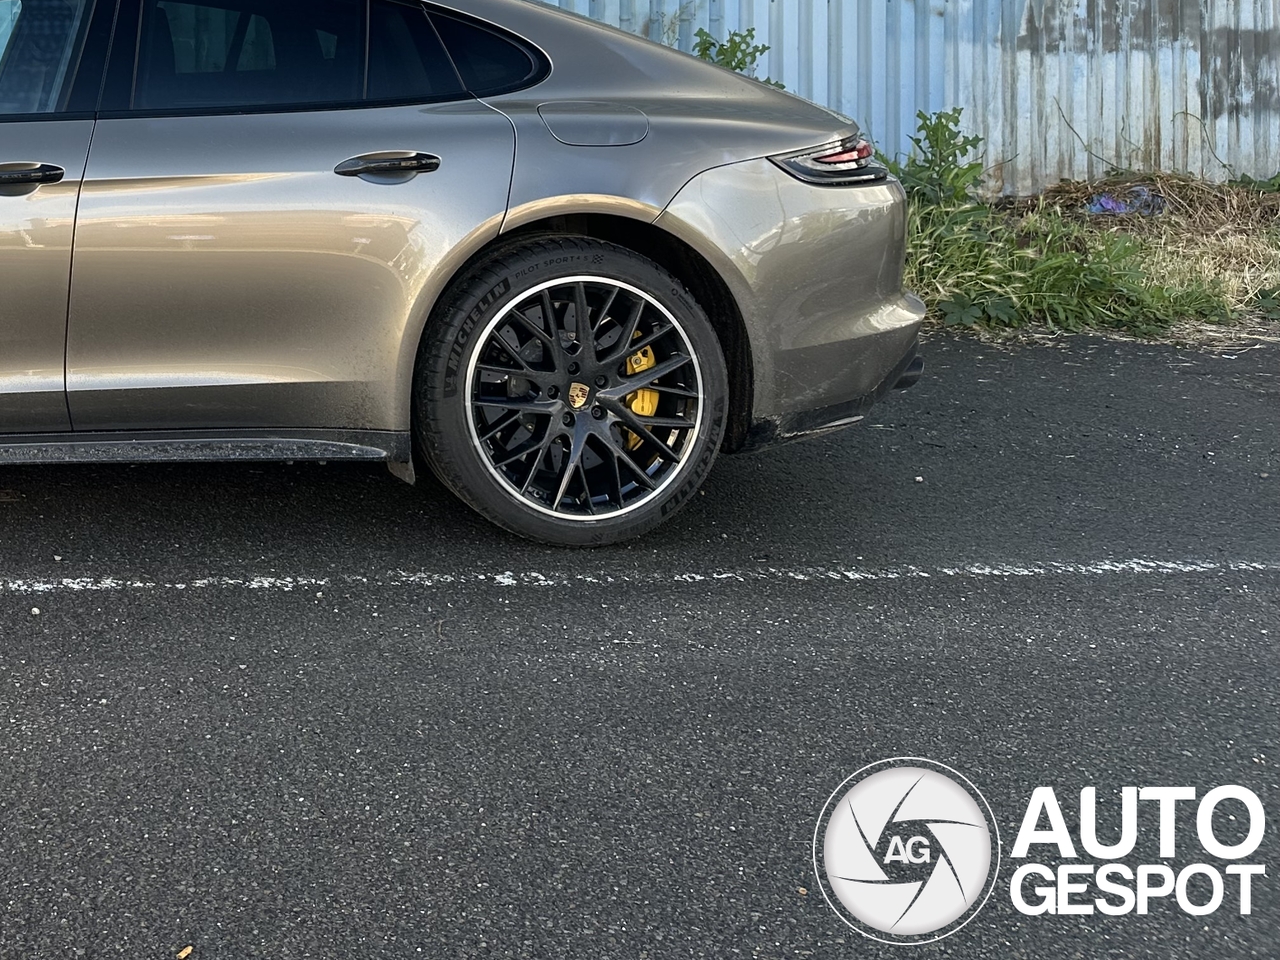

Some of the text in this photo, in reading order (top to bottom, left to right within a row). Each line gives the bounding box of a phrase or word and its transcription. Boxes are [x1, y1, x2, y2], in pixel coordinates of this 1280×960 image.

[515, 263, 540, 280] PILOT
[543, 255, 576, 268] SPORT
[447, 281, 506, 371] MICHELIN
